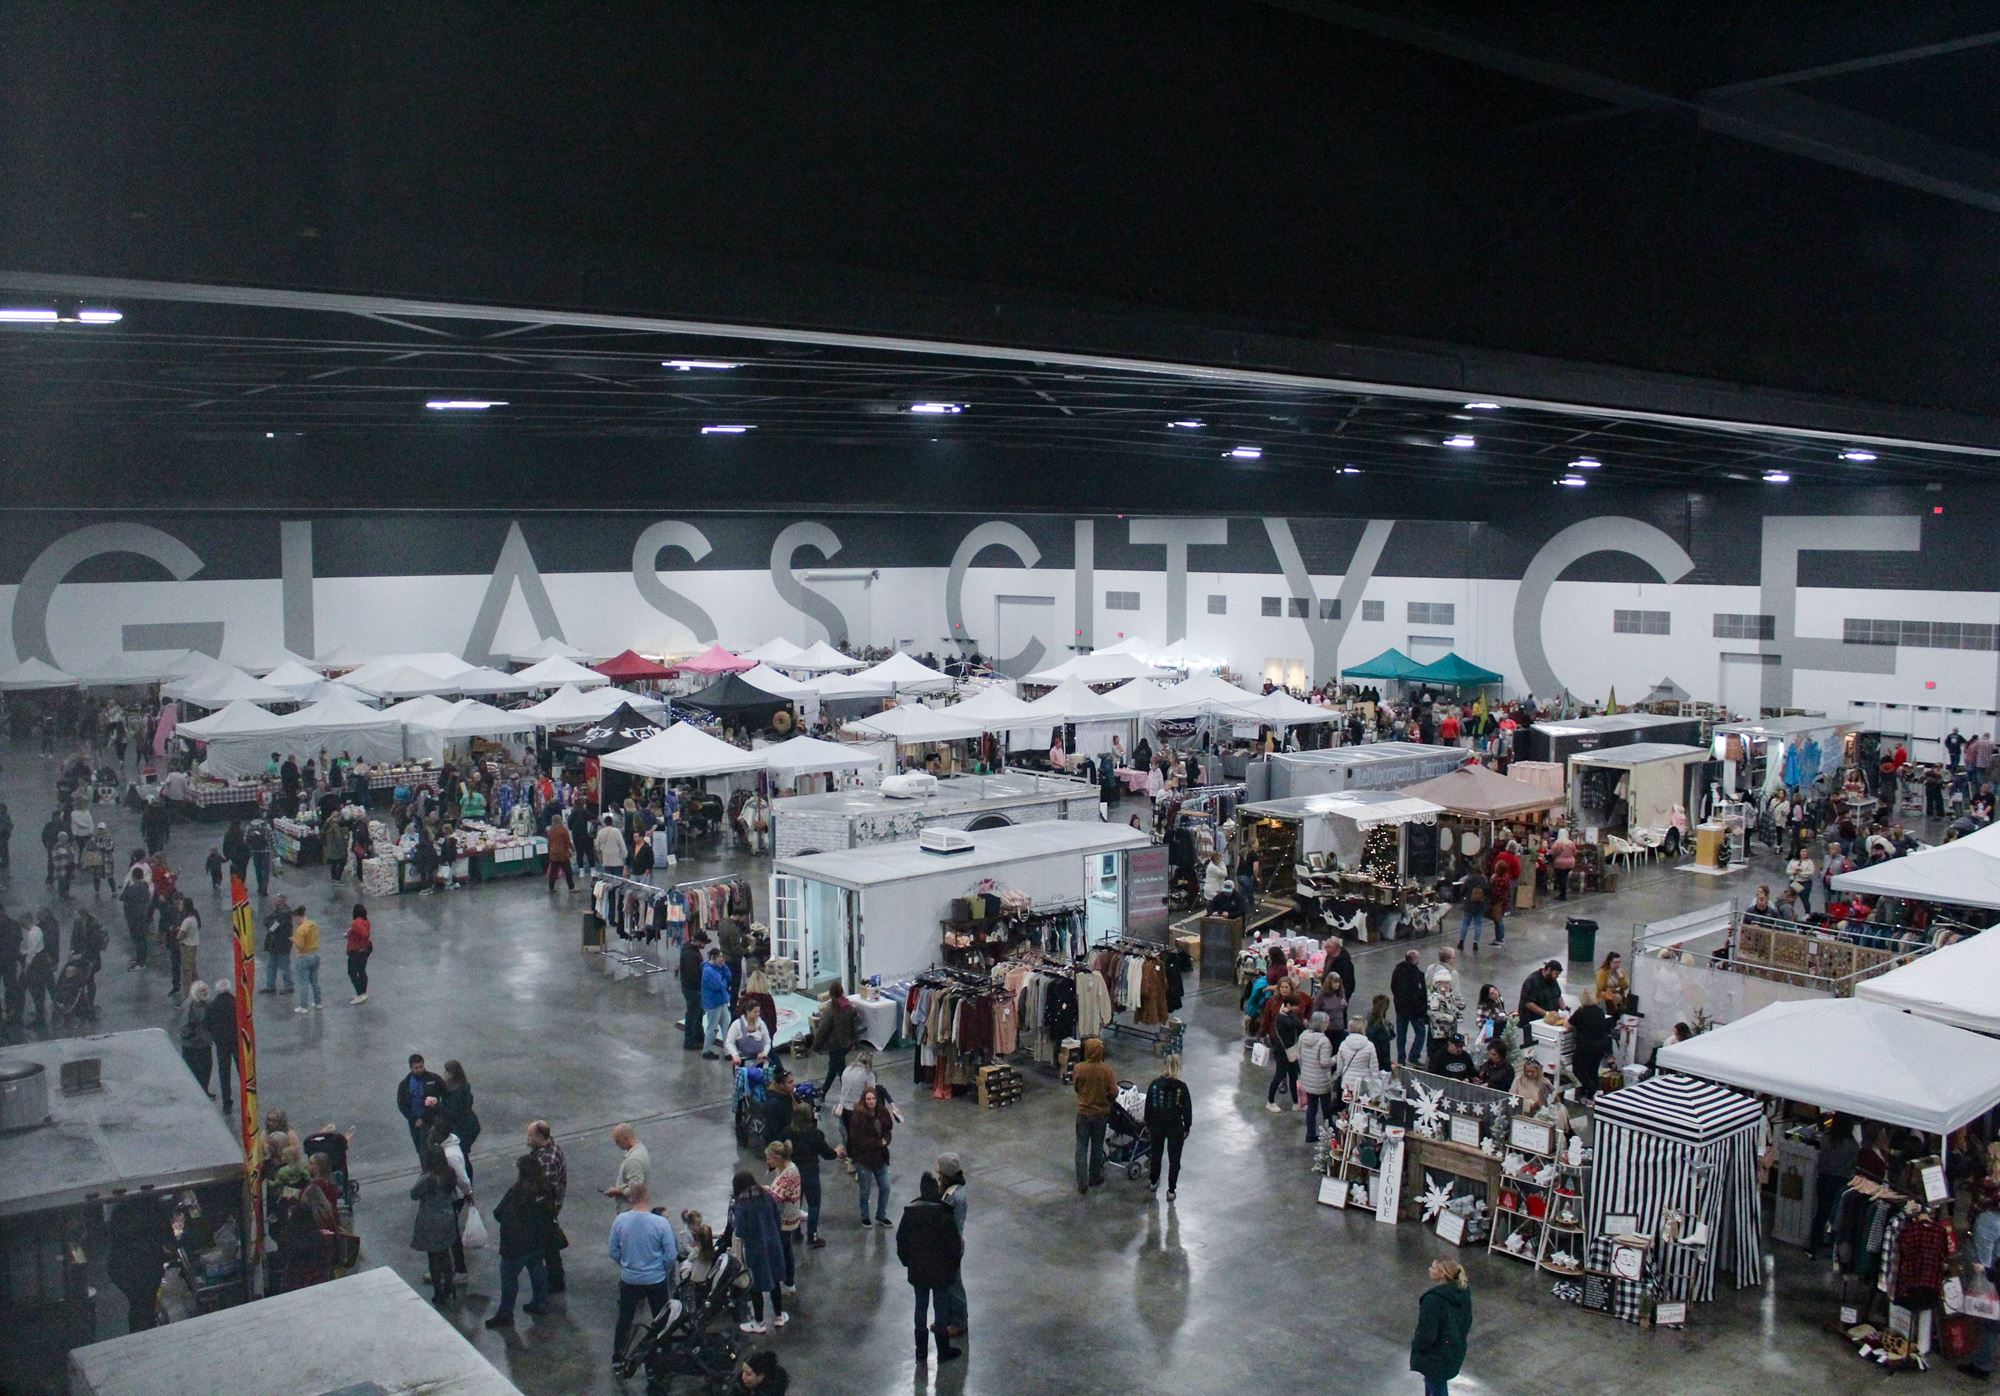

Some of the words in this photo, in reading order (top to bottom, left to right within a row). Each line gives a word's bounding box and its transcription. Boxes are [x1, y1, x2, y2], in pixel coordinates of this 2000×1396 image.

[946, 517, 1396, 686] CITY
[1513, 515, 2000, 710] CE
[1383, 1141, 1398, 1217] WELCOME
